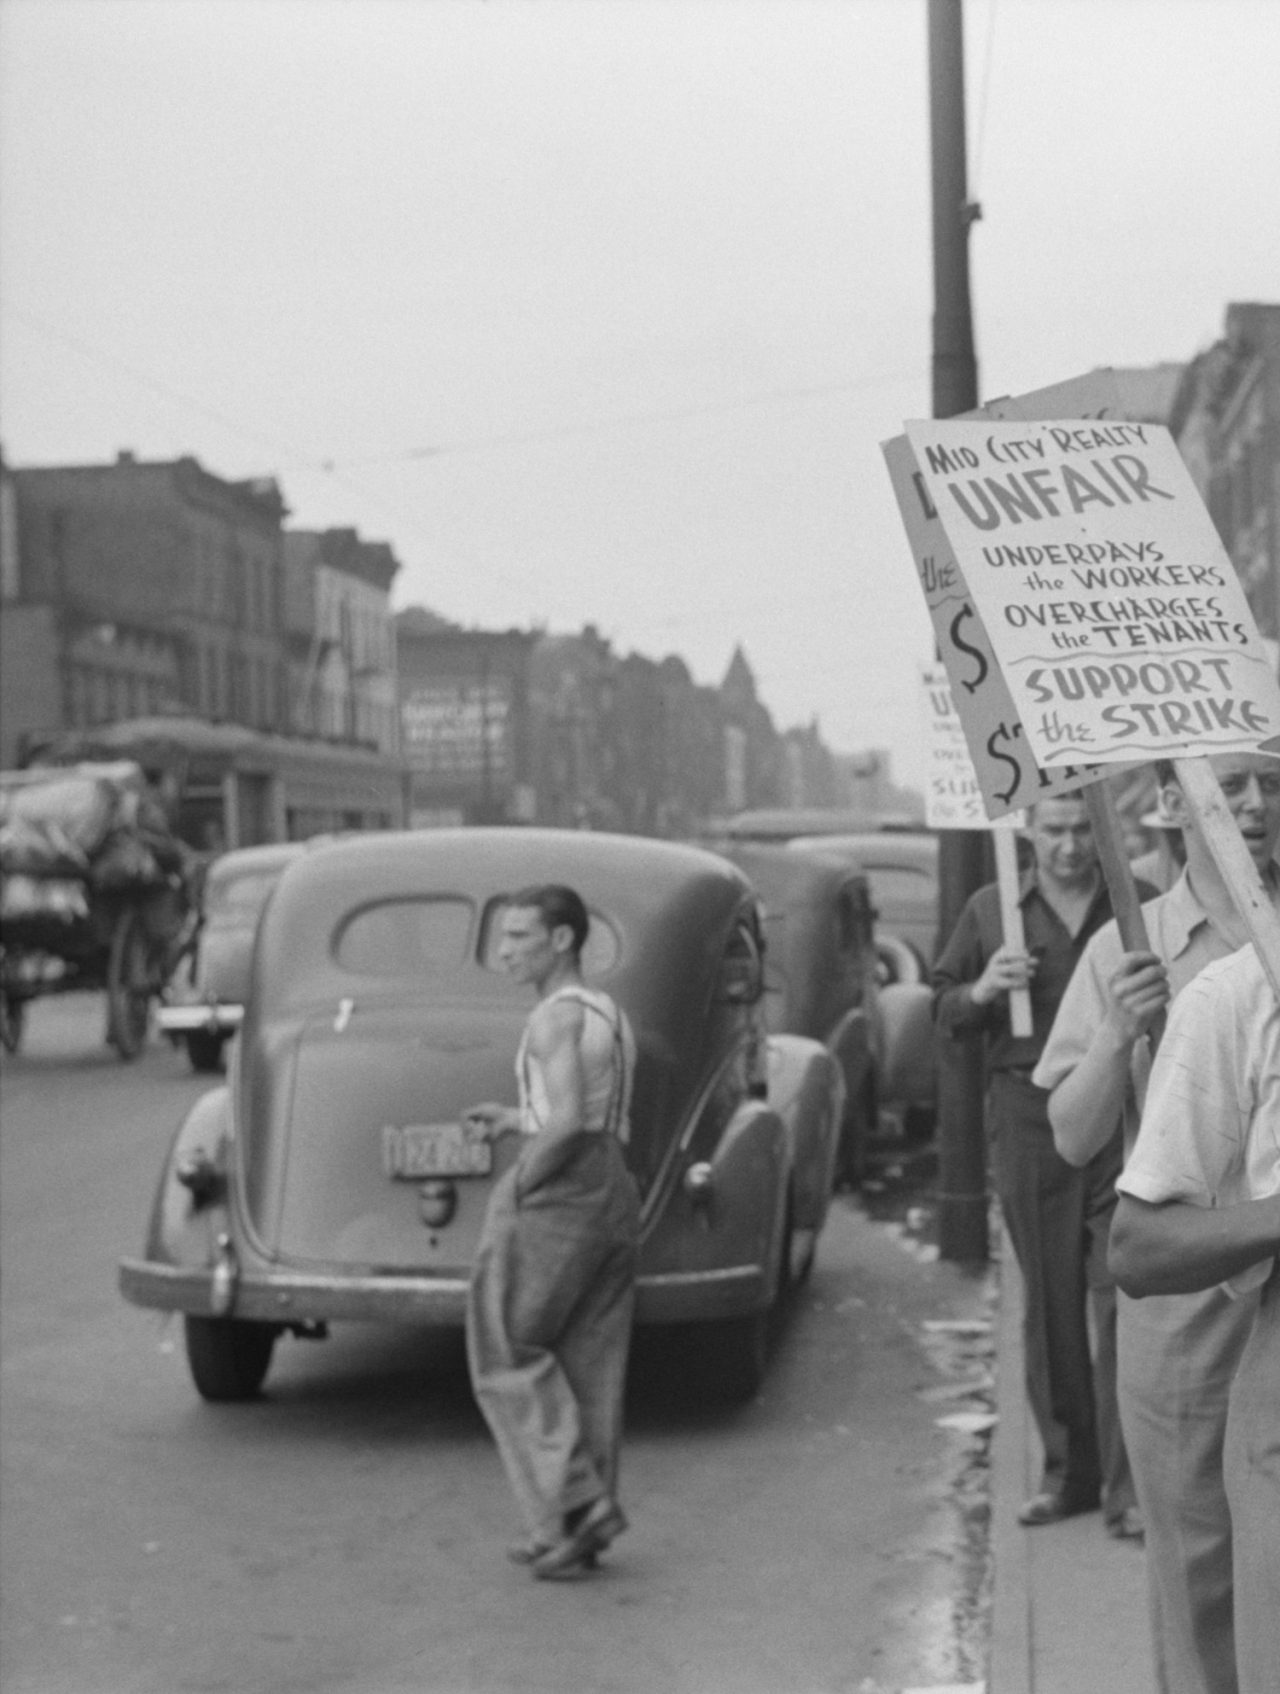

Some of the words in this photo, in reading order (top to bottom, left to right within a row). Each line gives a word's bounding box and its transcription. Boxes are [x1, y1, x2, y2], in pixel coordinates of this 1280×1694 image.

[947, 453, 1176, 531] UNFAIR
[982, 541, 1164, 567] UNDERPAYS
[1023, 571, 1064, 591] the
[1071, 565, 1225, 589] WORKERS
[1004, 597, 1222, 627] OVERCHARGES
[1051, 632, 1092, 649] the
[1092, 620, 1248, 647] TENANTS
[1025, 658, 1232, 703] SUPPORT
[1037, 710, 1096, 743] the
[1101, 698, 1270, 738] STRIKE
